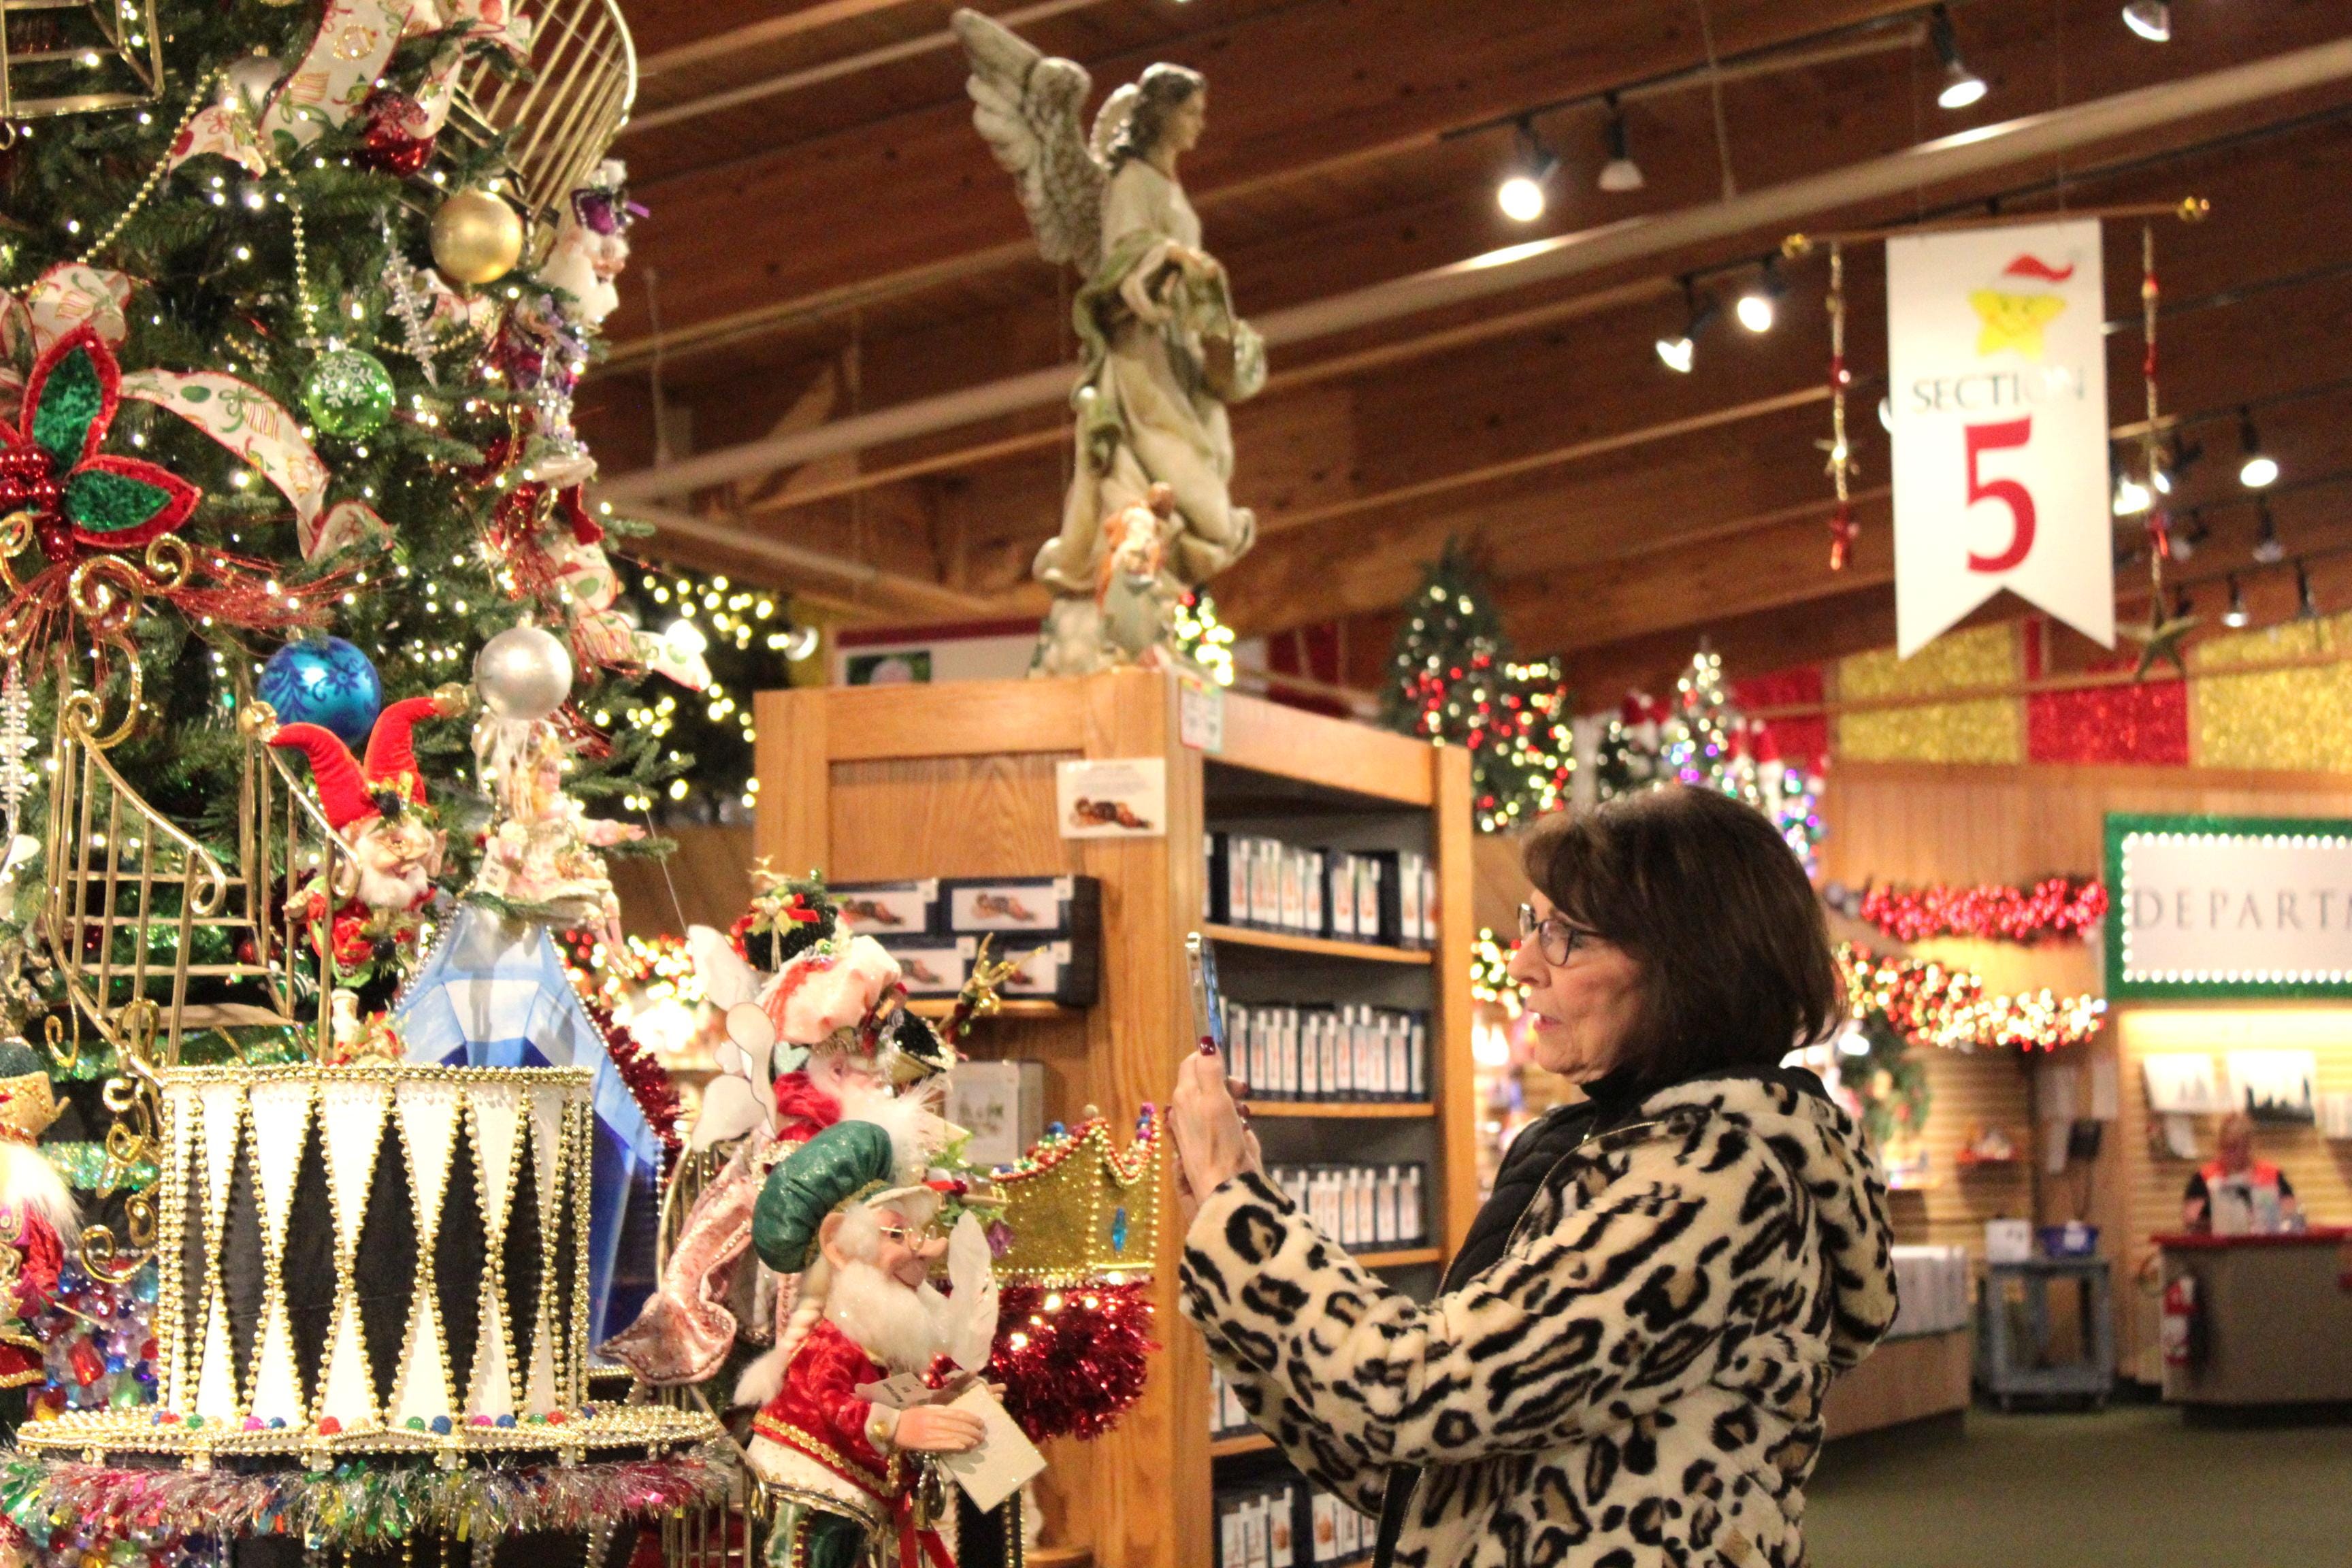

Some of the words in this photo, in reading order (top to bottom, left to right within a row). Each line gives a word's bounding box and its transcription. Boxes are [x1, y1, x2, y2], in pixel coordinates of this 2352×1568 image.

[1911, 365, 2087, 413] SECTIO
[1964, 412, 2036, 574] 5
[2133, 887, 2352, 930] DEPART
